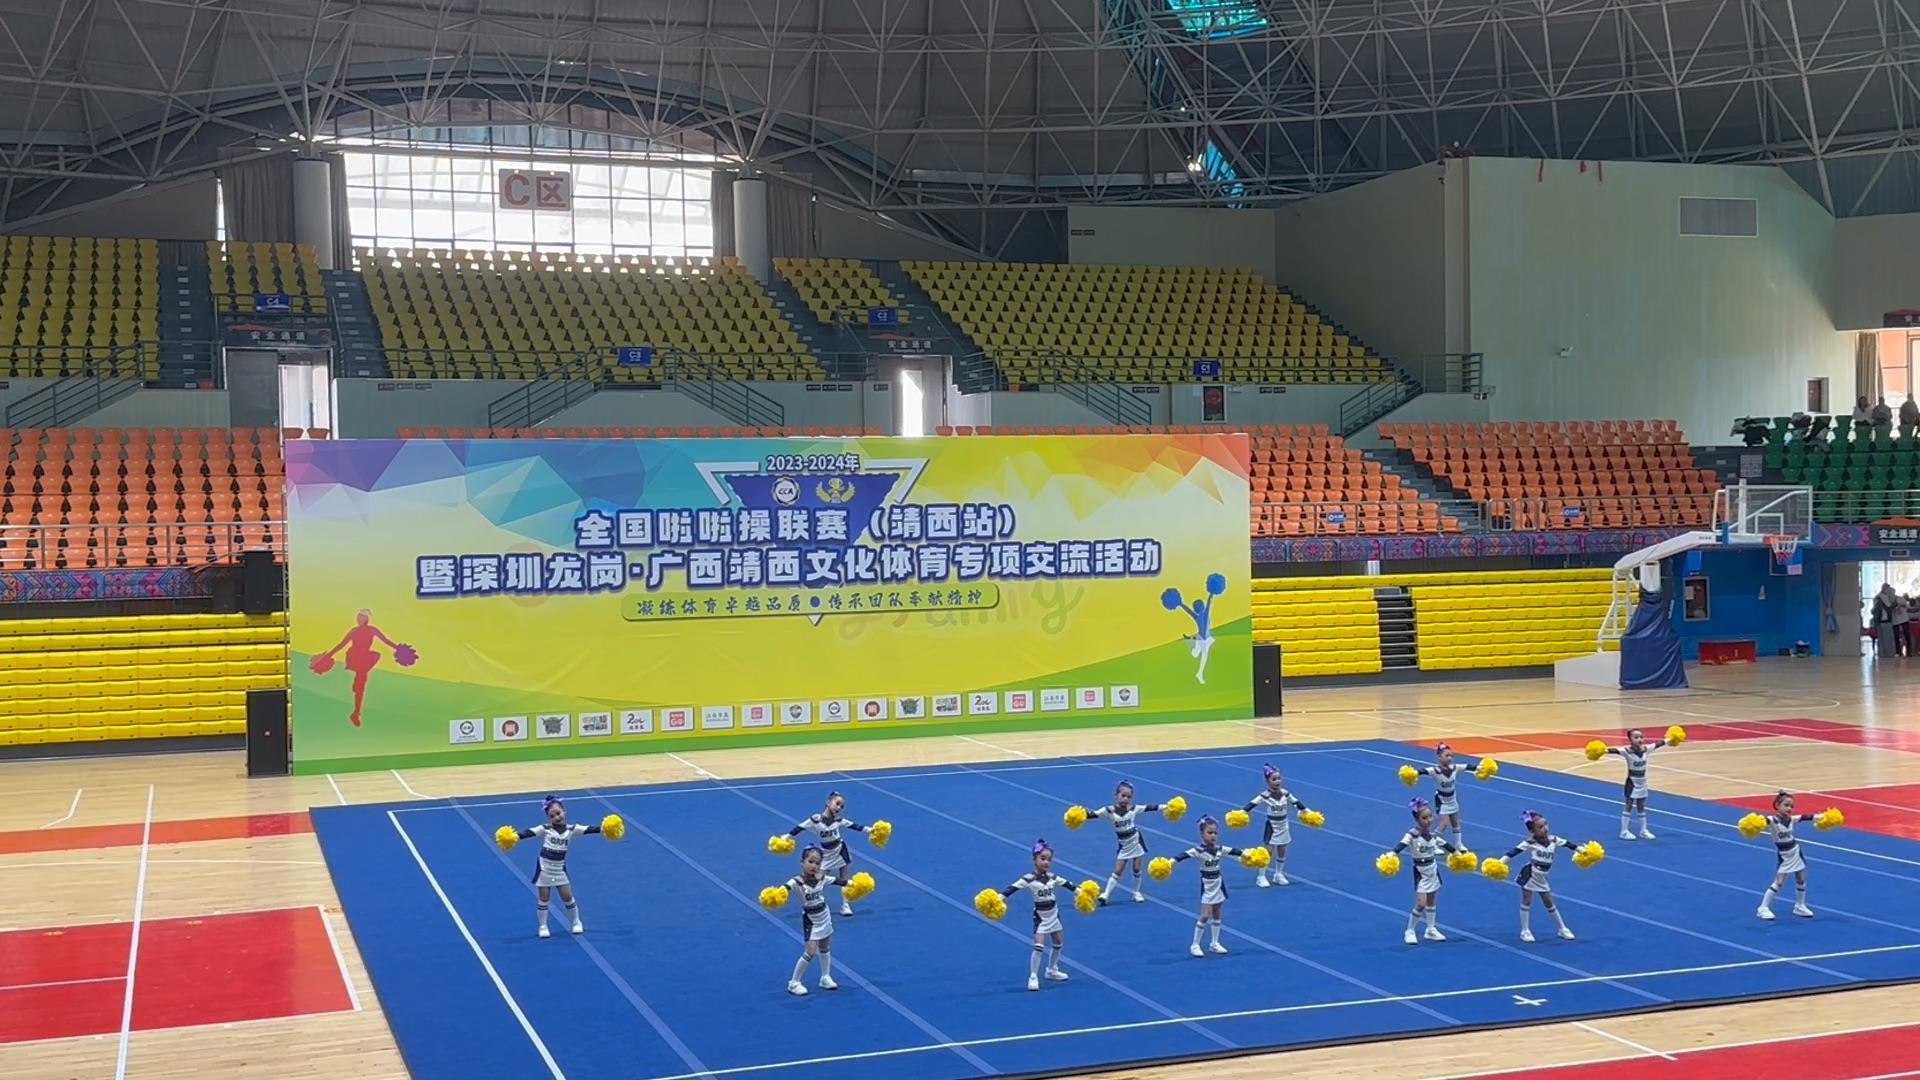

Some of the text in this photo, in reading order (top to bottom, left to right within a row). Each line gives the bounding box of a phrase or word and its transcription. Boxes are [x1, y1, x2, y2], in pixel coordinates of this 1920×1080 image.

[504, 174, 566, 208] C区
[266, 297, 280, 306] C4
[628, 351, 642, 359] C3
[766, 453, 860, 472] 2023-2024年
[778, 487, 794, 496] CCA
[1878, 529, 1918, 539] 安全通道
